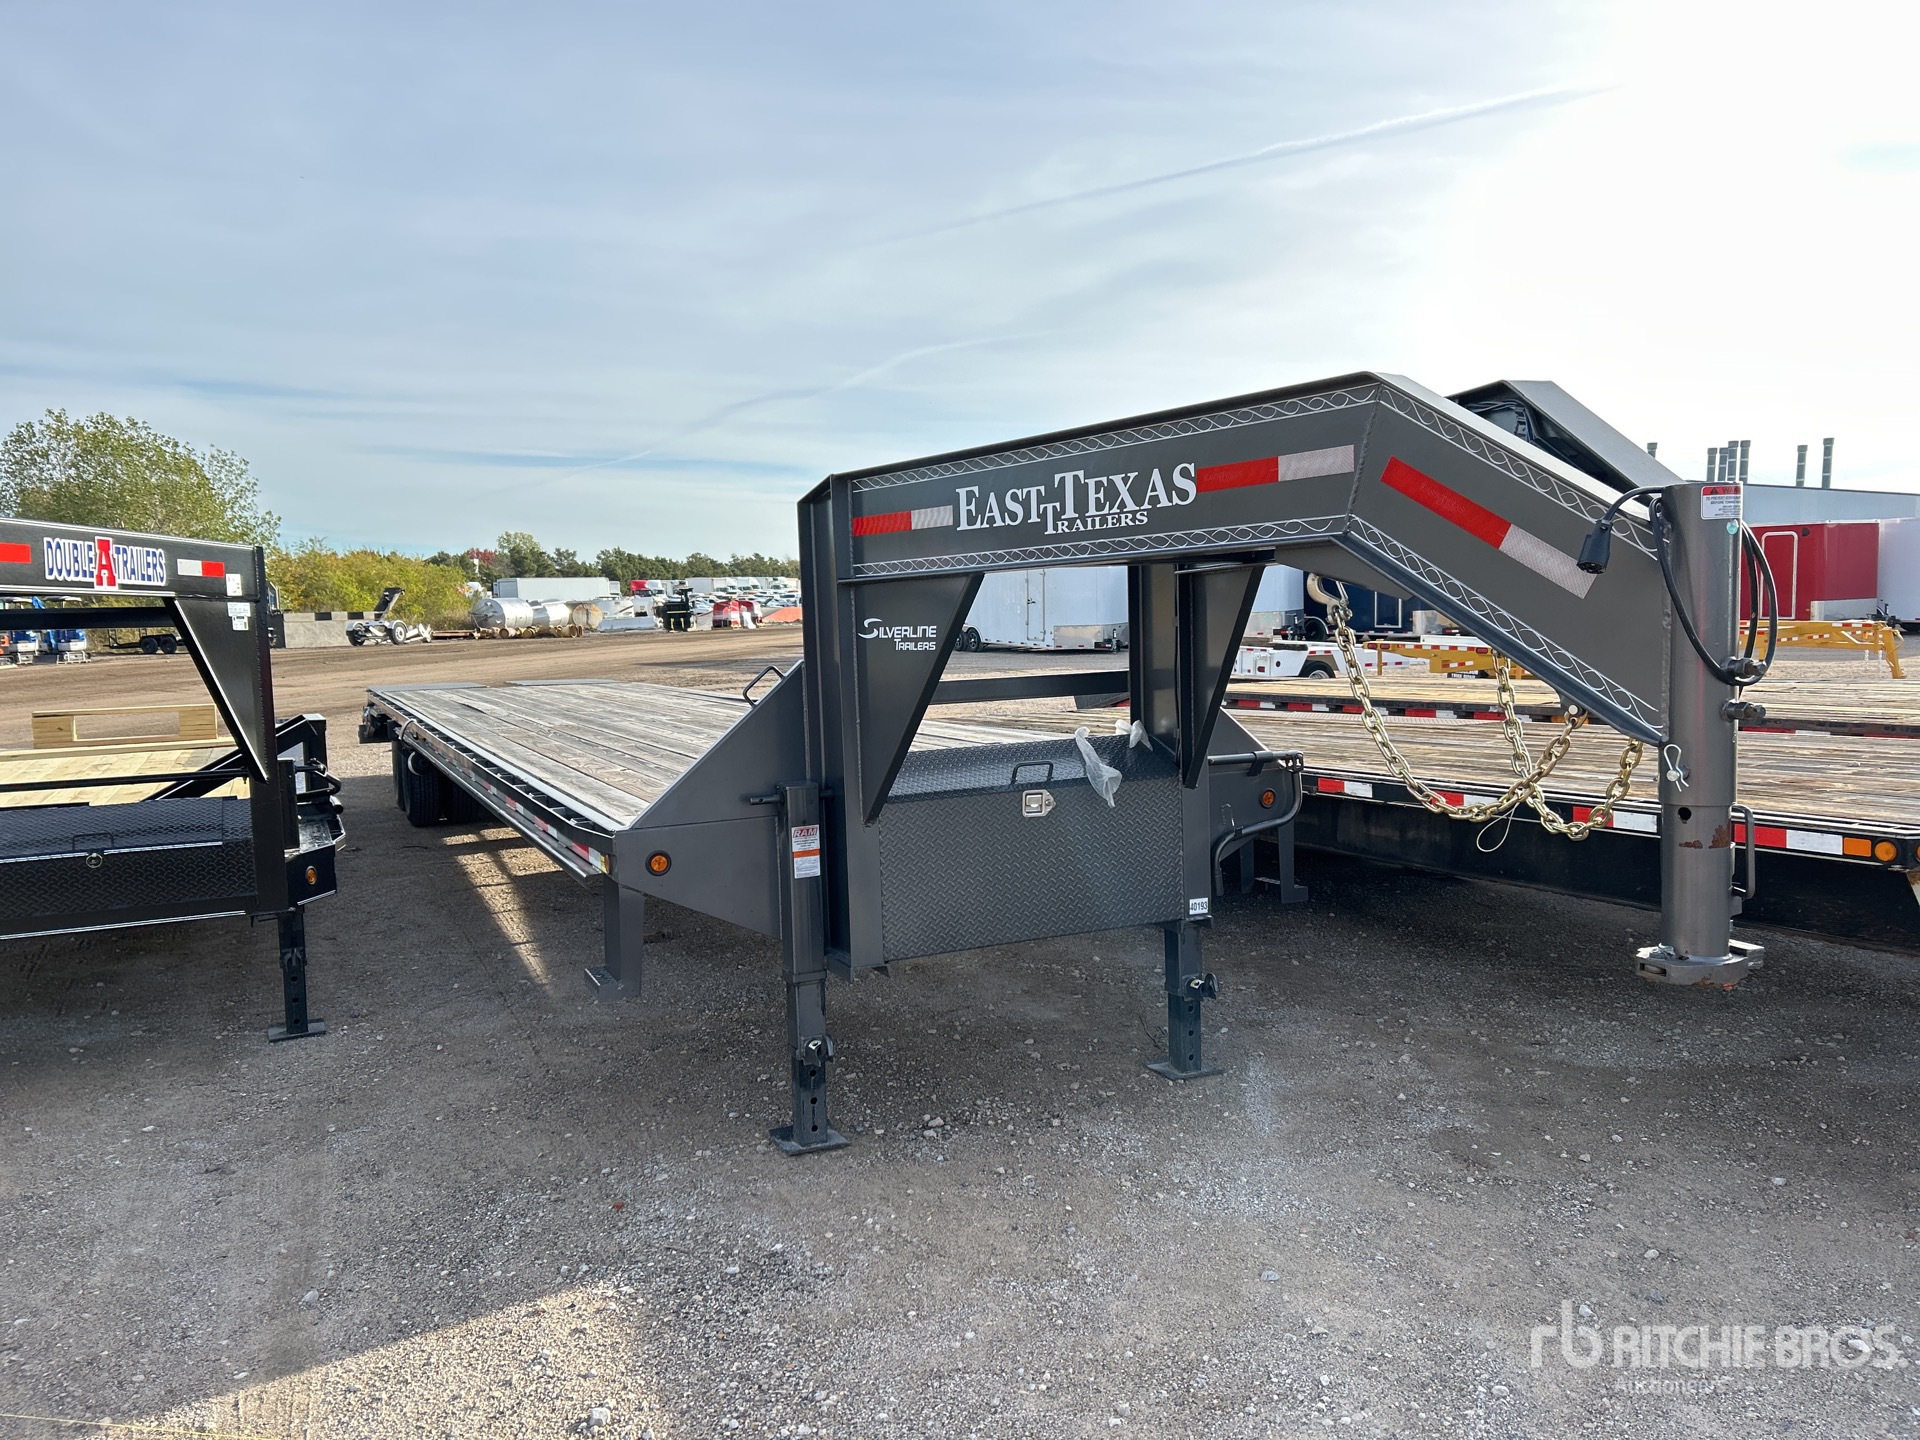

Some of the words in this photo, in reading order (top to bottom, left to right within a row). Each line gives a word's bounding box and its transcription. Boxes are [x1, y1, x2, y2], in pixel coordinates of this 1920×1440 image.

[956, 485, 1045, 531] EAST
[1054, 462, 1197, 520] TEXAS
[1040, 502, 1149, 535] TRAILERS
[44, 537, 95, 581] DOUBLE
[94, 536, 118, 590] A
[112, 545, 167, 586] TRAILERS
[858, 618, 937, 639] SILVERLINE
[894, 639, 936, 651] TRAILERS
[793, 828, 818, 838] RAM
[1190, 901, 1208, 910] 40193
